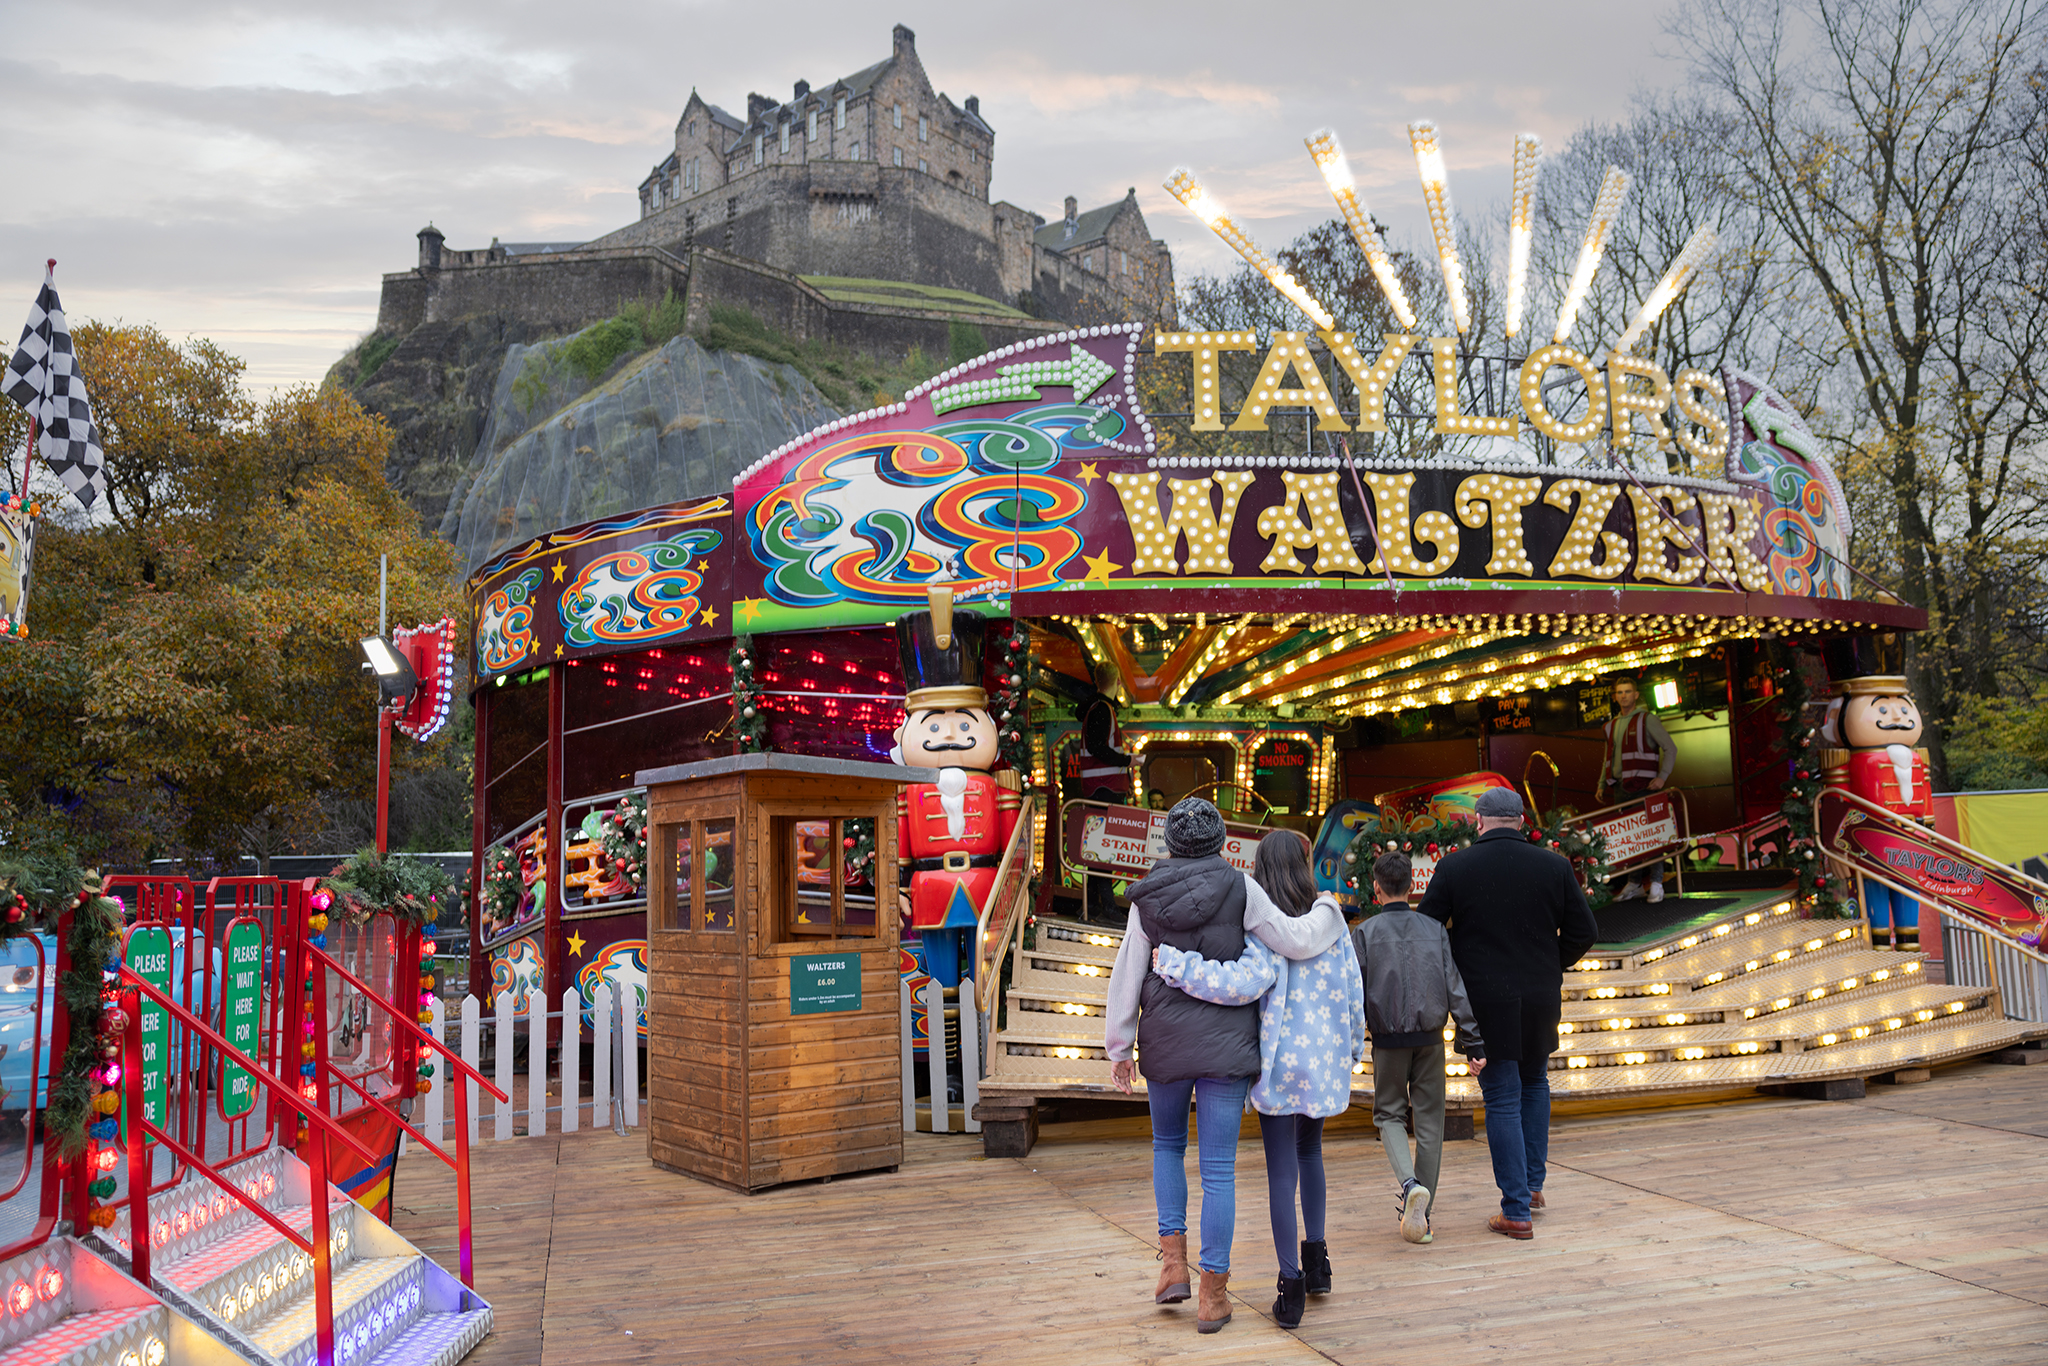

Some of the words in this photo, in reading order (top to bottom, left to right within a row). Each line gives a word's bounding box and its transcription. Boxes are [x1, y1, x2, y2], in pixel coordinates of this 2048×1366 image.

[1155, 328, 1729, 459] TAYLORS
[1107, 471, 1769, 592] WALTZER
[1497, 698, 1515, 712] PAY
[1493, 714, 1512, 729] THE
[1512, 716, 1532, 730] CAR
[1274, 742, 1289, 754] NO
[1259, 754, 1305, 767] SMOKING
[1651, 803, 1664, 814] EXIT
[1108, 816, 1147, 828] ENTRANCE
[1633, 823, 1666, 841] WHILST
[1116, 853, 1151, 866] RIDE
[1617, 848, 1627, 858] IN
[1326, 860, 1332, 876] 1
[1884, 847, 1985, 885] TAYLORS
[1924, 881, 1974, 896] Edinburgh
[233, 946, 258, 963] PLEASE
[134, 954, 166, 973] PLEASE
[806, 962, 846, 971] WALTZERS
[236, 972, 254, 989] WAIT
[817, 978, 836, 986] £6.00
[235, 996, 253, 1016] HERE
[236, 1023, 250, 1042] FOR
[142, 1042, 156, 1062] OR
[143, 1071, 158, 1092] EXT
[232, 1075, 248, 1096] RIDE
[144, 1101, 156, 1120] DE
